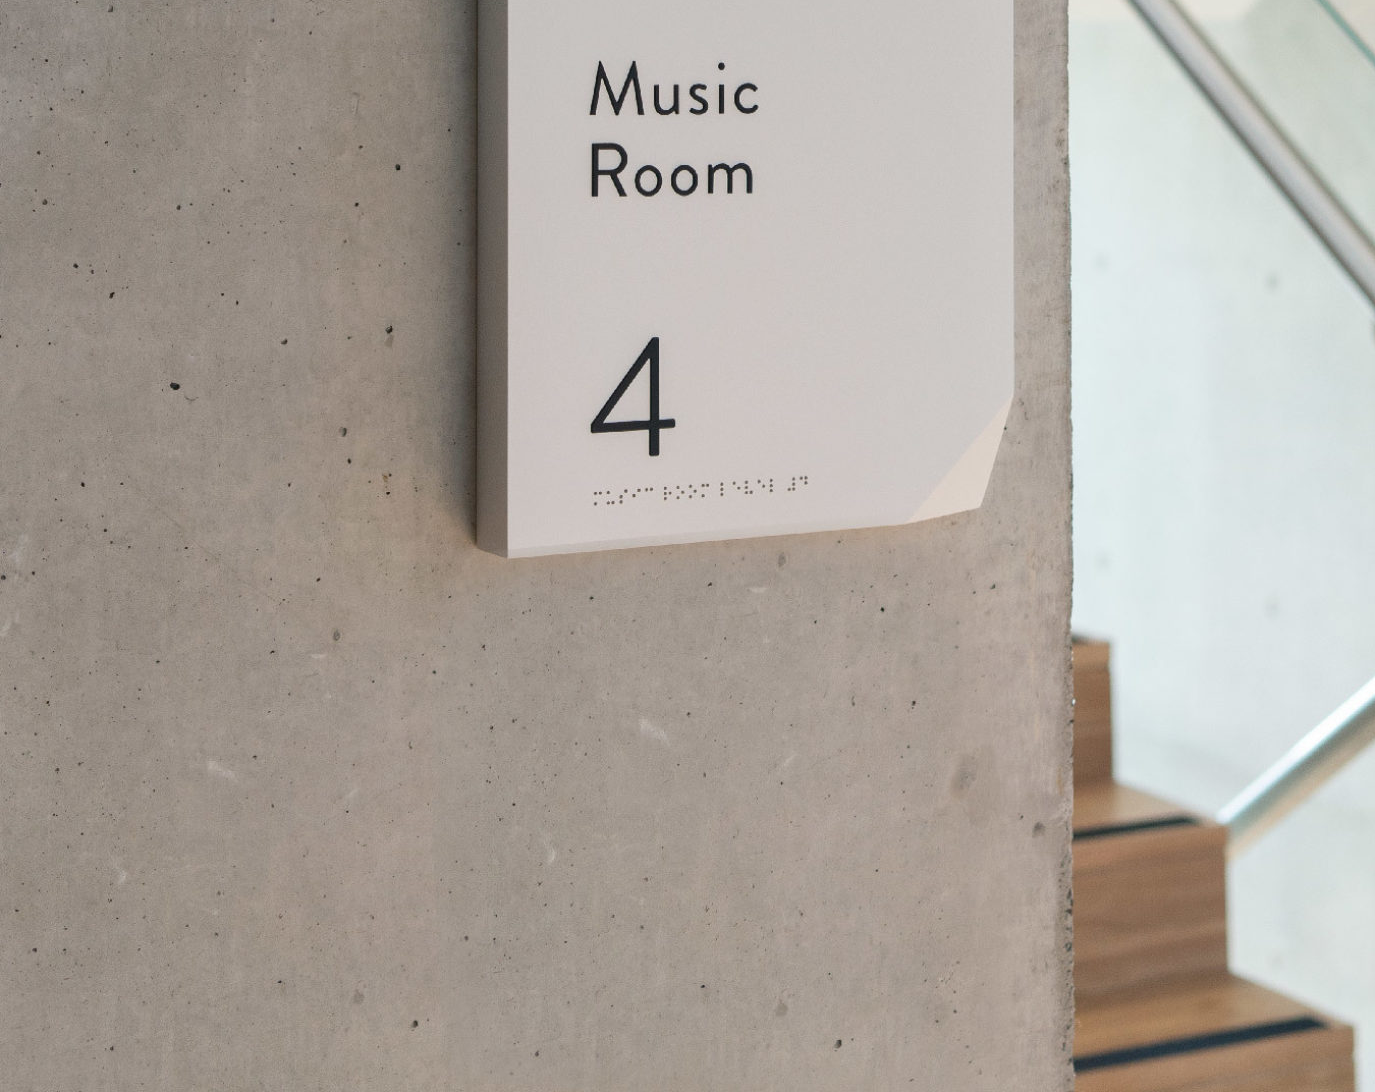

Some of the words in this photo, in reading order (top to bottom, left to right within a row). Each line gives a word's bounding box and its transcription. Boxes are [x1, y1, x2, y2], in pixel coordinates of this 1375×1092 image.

[589, 60, 760, 116] Music
[590, 142, 754, 198] Room
[590, 336, 676, 457] 4
